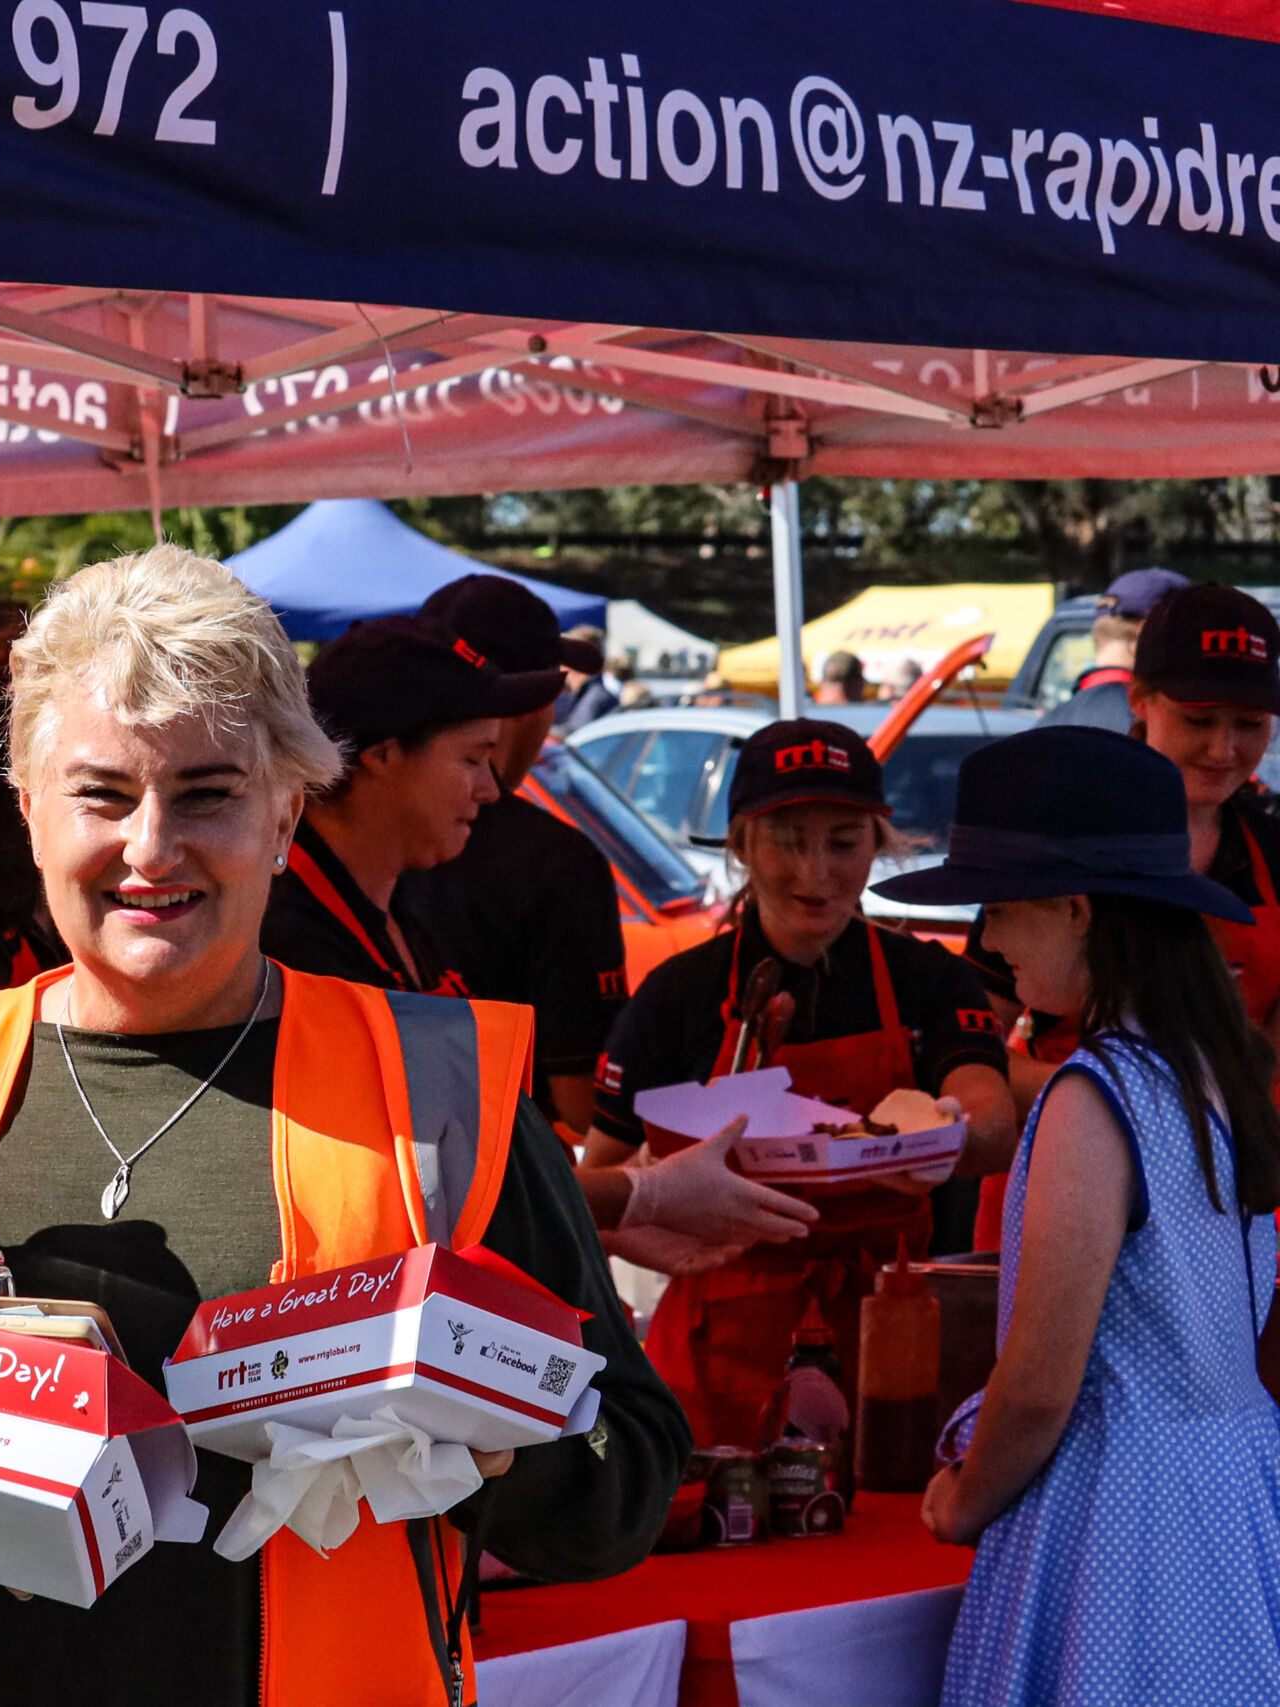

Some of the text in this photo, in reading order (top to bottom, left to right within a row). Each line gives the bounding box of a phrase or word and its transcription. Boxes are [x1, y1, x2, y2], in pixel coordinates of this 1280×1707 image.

[12, 3, 219, 146] 972
[210, 1257, 404, 1333] Have a Great Day!
[298, 1343, 361, 1364] www.rrtglobal.org
[496, 1351, 538, 1376] facebook
[218, 1360, 247, 1391] rrt
[232, 1397, 268, 1411] COMMUNITY
[275, 1387, 313, 1401] COMPASSION
[320, 1379, 348, 1391] SUPPORT
